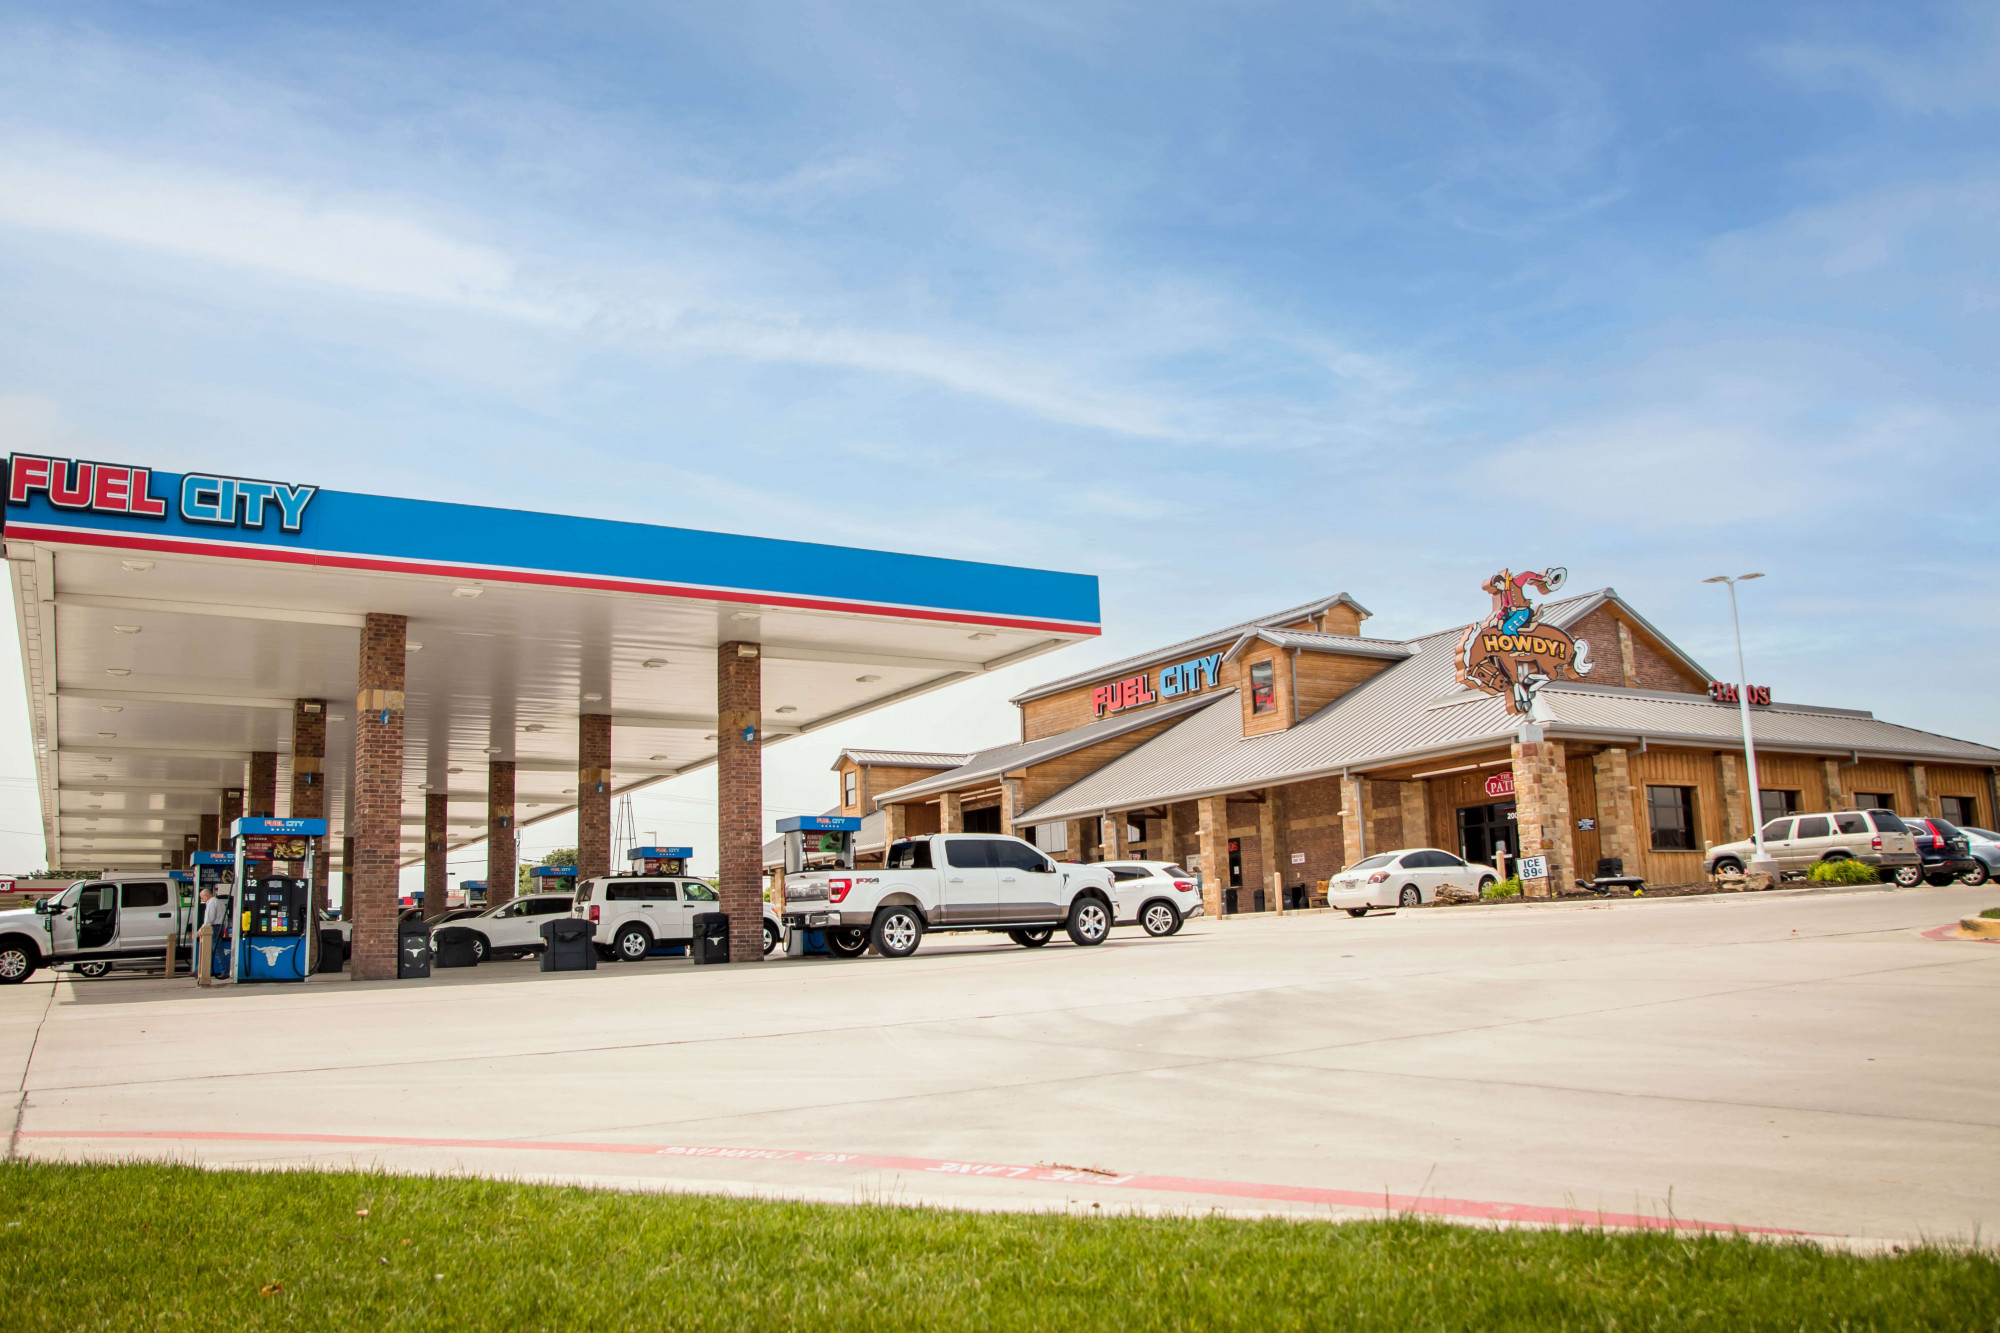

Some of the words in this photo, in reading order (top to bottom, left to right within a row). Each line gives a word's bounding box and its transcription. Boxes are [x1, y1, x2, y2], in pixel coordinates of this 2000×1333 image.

[8, 453, 167, 520] FUEL
[180, 473, 319, 533] CITY
[1482, 634, 1566, 660] HOWDY!
[1093, 674, 1156, 717] FUEL
[1160, 652, 1224, 698] CITY
[1490, 780, 1515, 793] PATI
[1523, 858, 1540, 869] ICE
[0, 881, 12, 891] QT
[925, 1162, 1030, 1177] LANE
